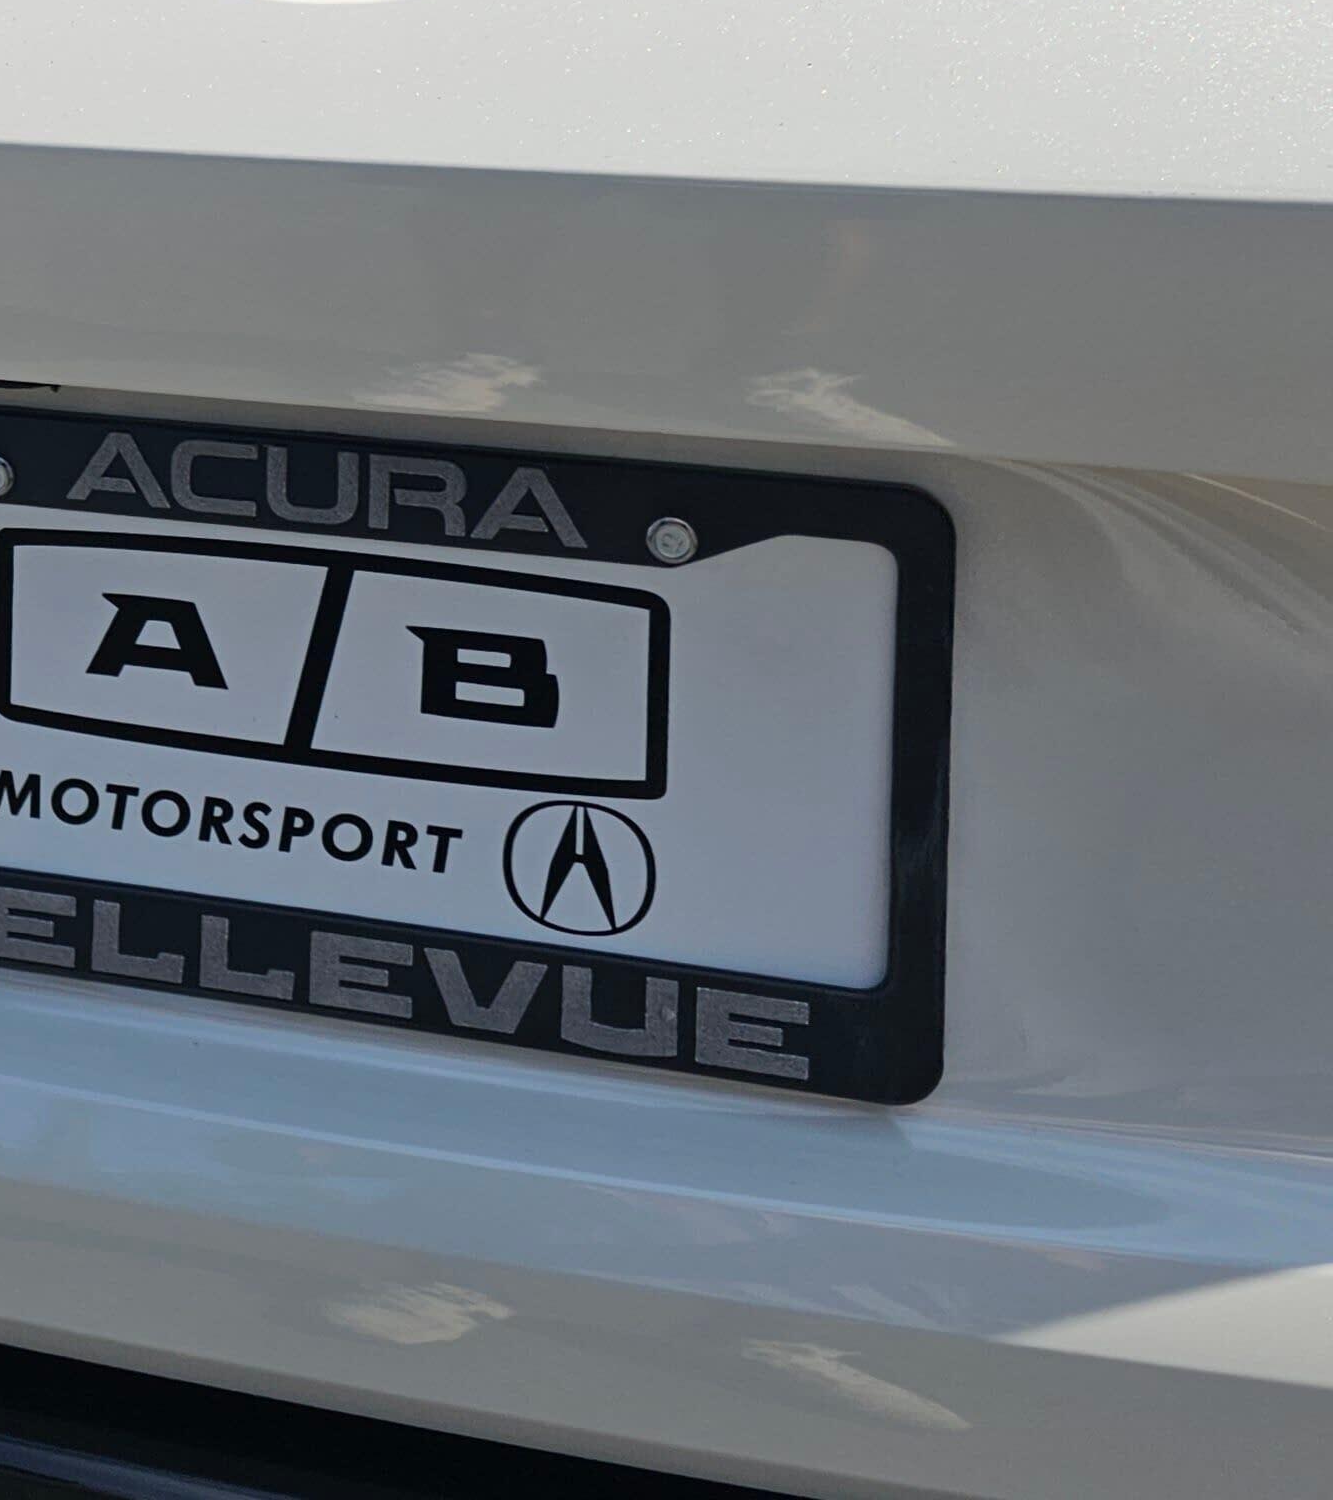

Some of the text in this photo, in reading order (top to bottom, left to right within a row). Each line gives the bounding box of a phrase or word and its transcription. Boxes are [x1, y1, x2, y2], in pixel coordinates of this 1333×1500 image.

[66, 433, 587, 548] ACURA
[86, 592, 558, 728] A B
